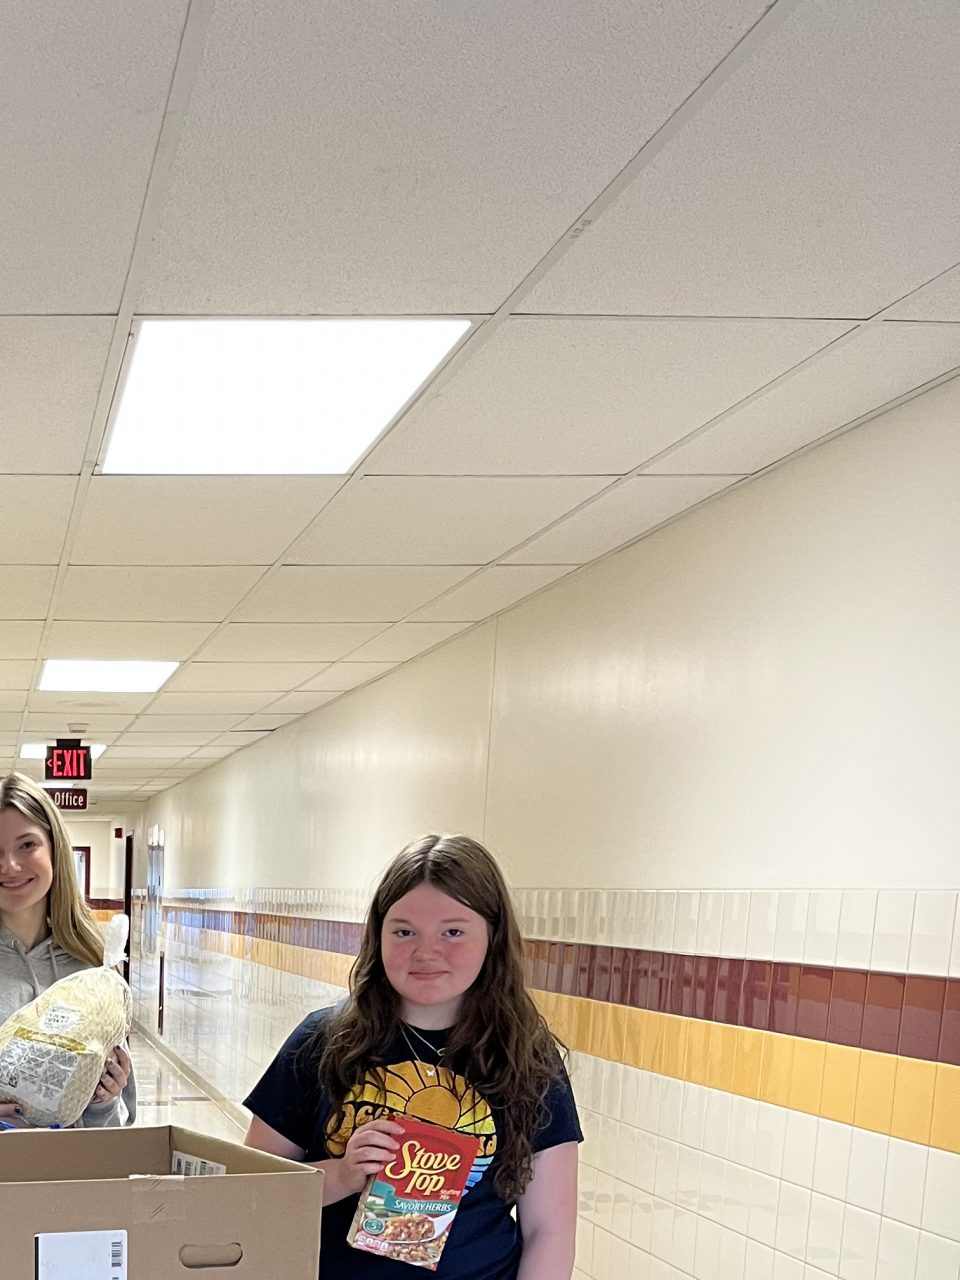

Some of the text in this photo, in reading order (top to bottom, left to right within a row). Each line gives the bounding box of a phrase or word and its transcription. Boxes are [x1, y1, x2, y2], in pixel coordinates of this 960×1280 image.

[53, 749, 87, 777] EXIT
[54, 791, 84, 806] Office
[385, 1140, 461, 1179] Stove
[404, 1168, 445, 1196] Top
[394, 1200, 452, 1212] SAVORY HERBS
